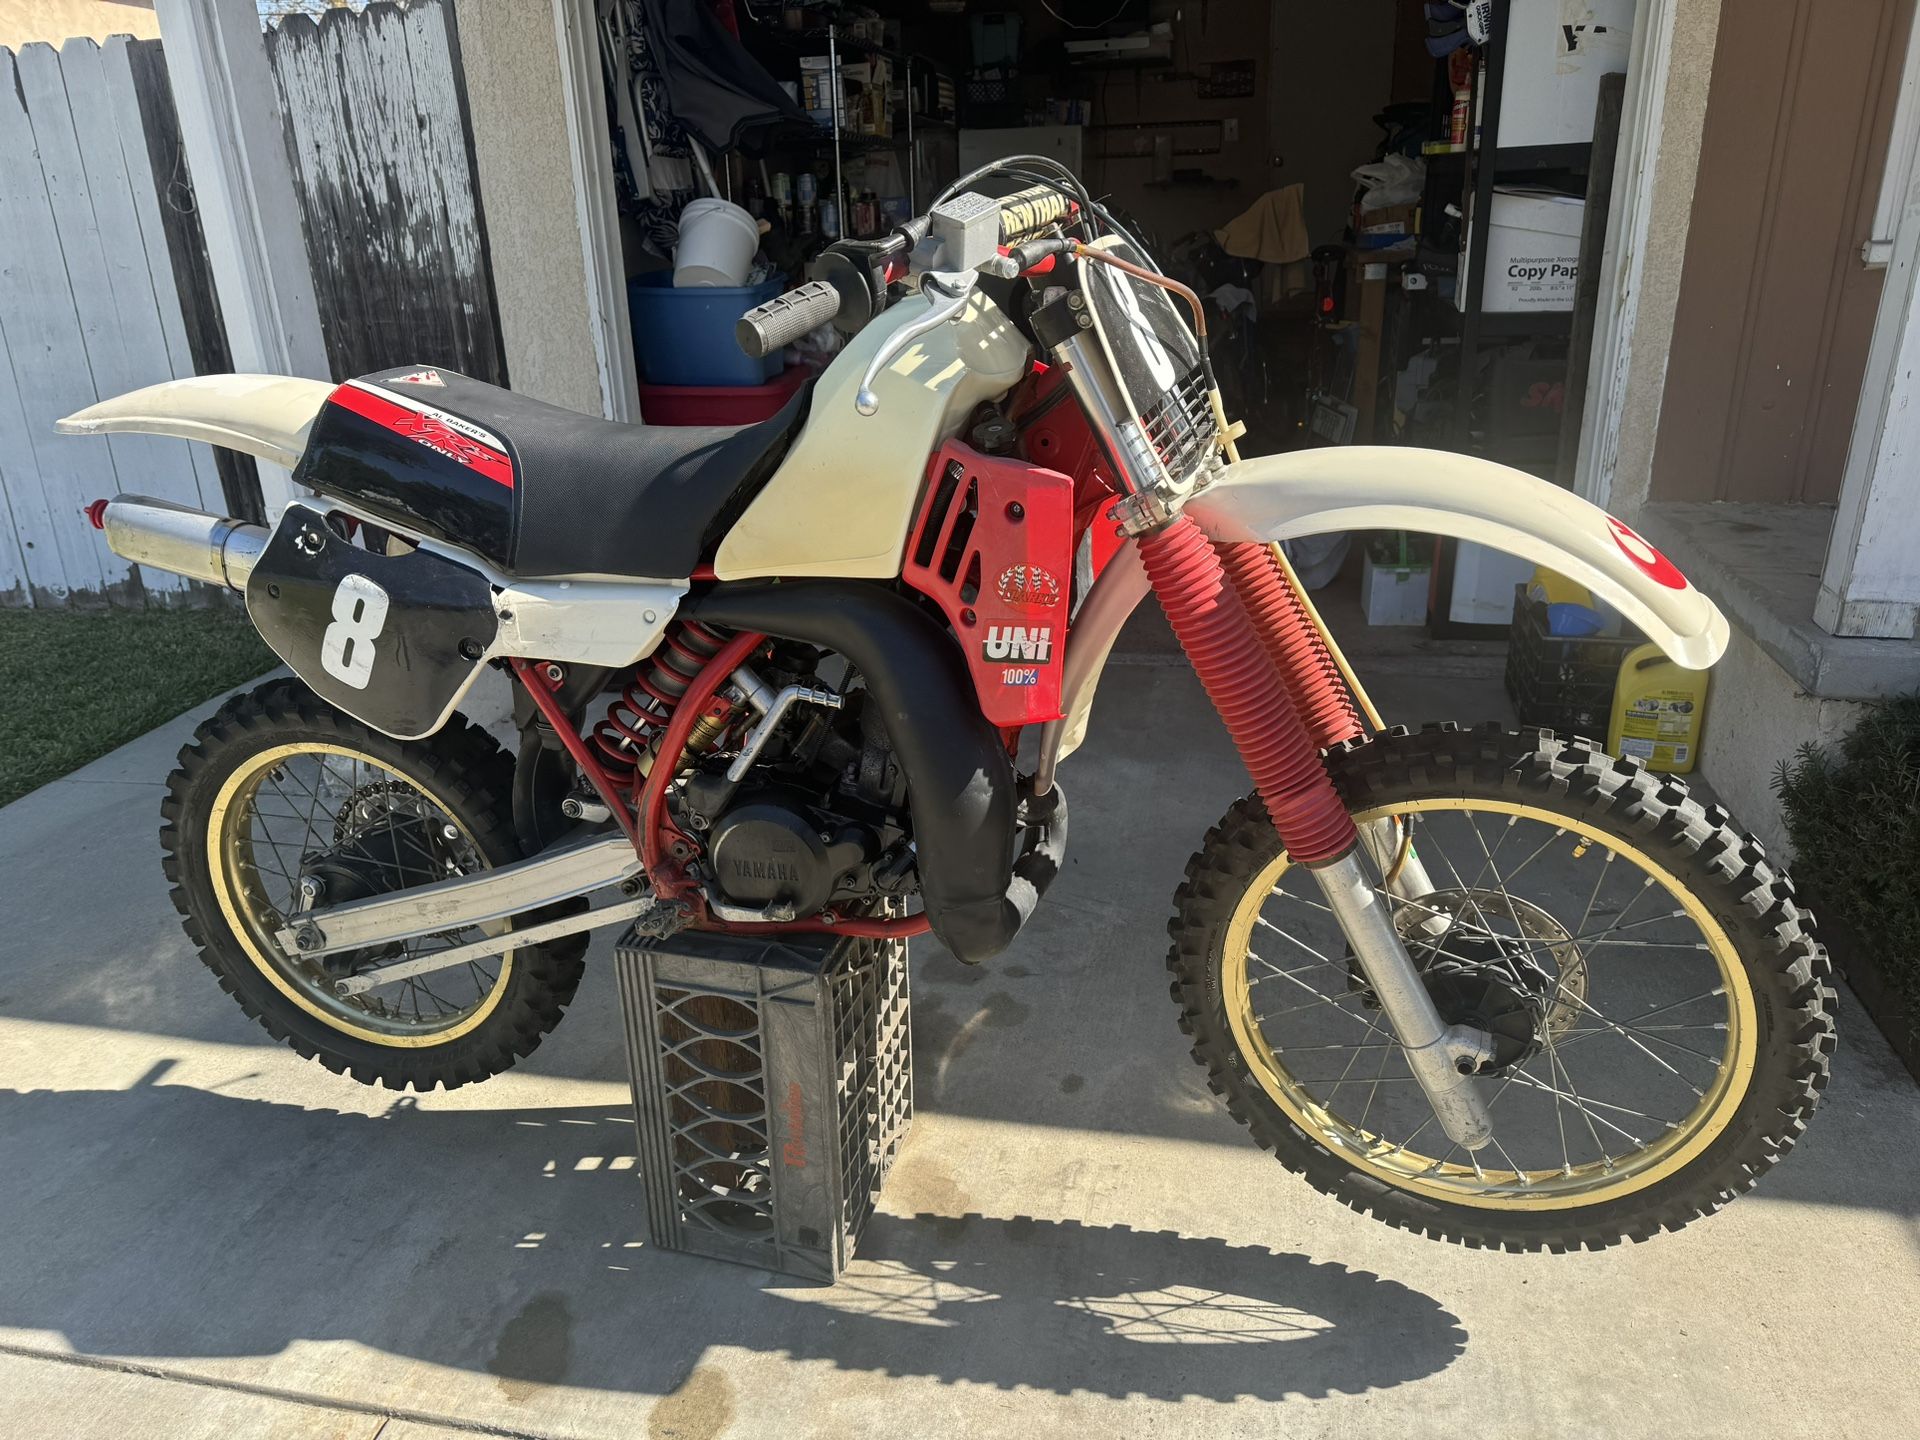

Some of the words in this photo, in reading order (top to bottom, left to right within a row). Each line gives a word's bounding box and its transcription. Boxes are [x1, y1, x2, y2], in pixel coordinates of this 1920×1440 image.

[1481, 2, 1491, 35] IRWIN
[1002, 193, 1067, 236] RENTHAL
[1508, 264, 1547, 280] Copy
[432, 412, 442, 420] AL
[446, 417, 488, 438] BAKER'S
[418, 439, 471, 463] ONLY
[321, 574, 390, 690] 8
[986, 626, 1051, 660] UNI
[1002, 668, 1036, 684] 100%
[733, 859, 799, 881] YAMAHA
